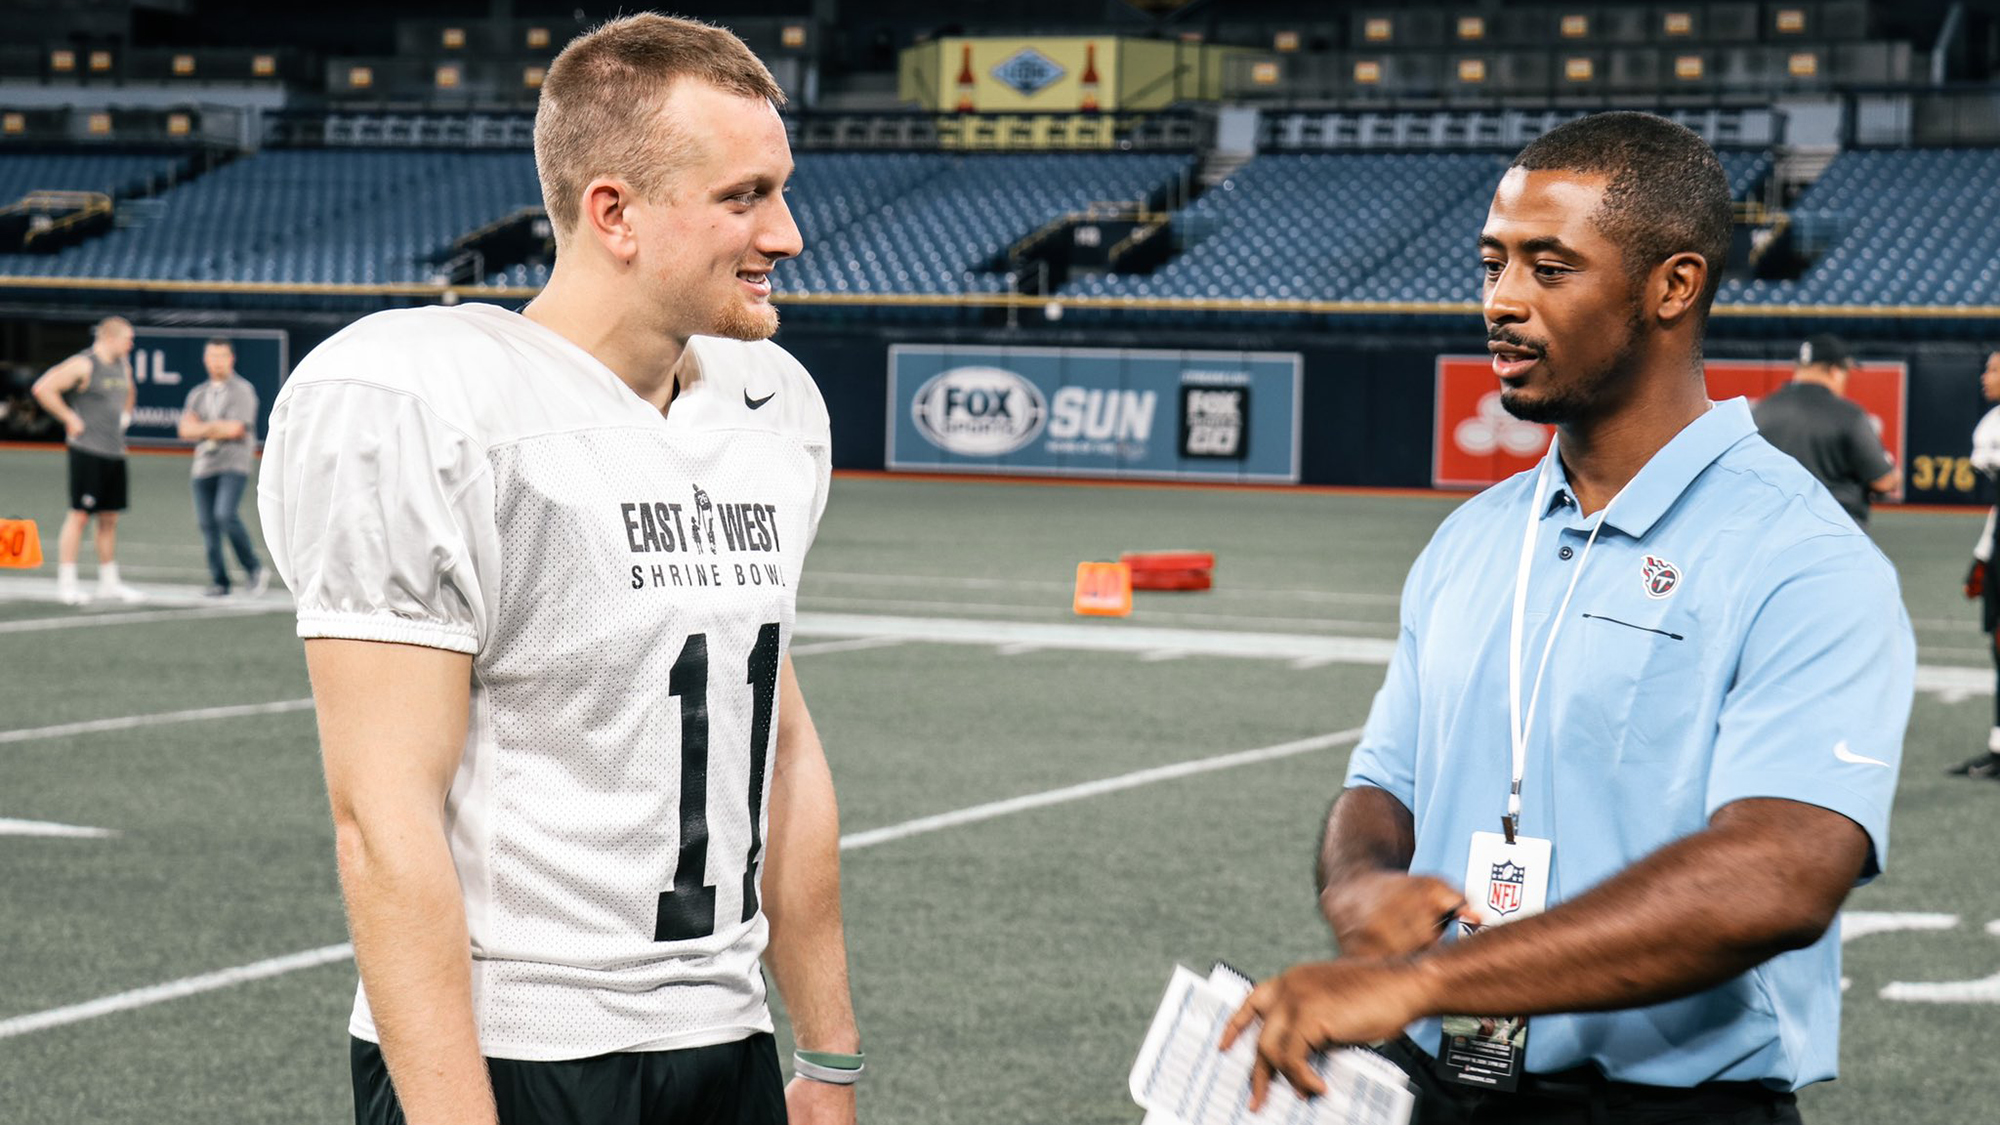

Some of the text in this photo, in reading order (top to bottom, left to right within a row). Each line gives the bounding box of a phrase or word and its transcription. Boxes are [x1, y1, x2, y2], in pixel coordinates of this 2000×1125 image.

[946, 388, 1012, 417] FOX
[1049, 386, 1158, 440] SUN
[620, 502, 781, 553] EAST WEST
[631, 563, 722, 590] SHRINE
[653, 622, 780, 942] 11
[1491, 882, 1517, 909] NFL
